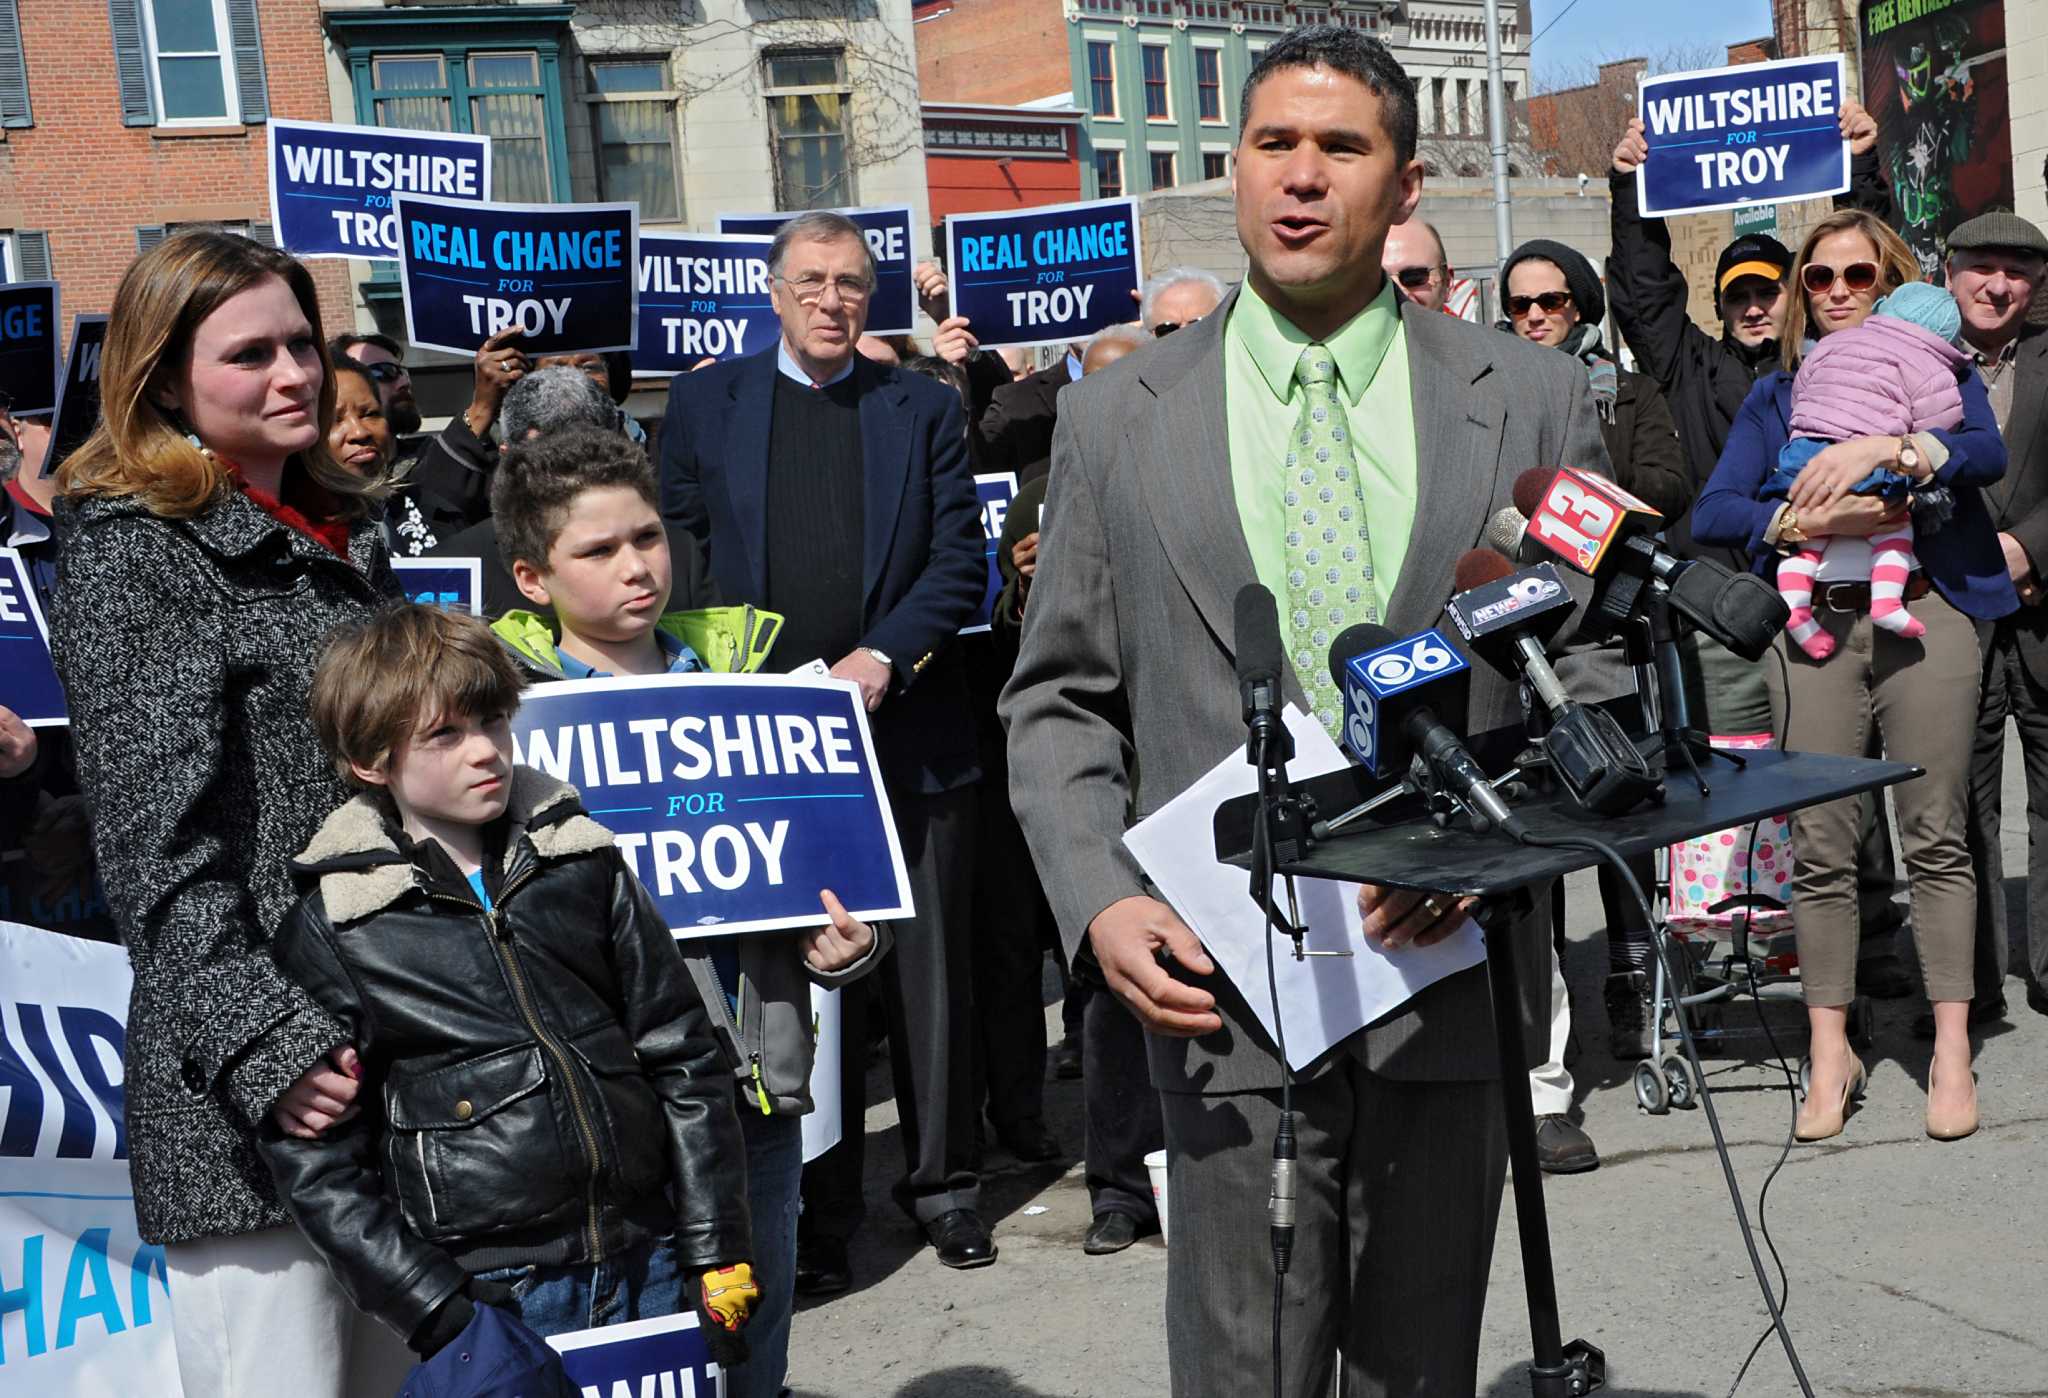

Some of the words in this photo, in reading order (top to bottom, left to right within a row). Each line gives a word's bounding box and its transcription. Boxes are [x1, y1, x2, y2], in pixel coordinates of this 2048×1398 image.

[1647, 78, 1834, 136] WILTSHIRE
[1725, 130, 1757, 145] FOR
[282, 144, 477, 195] WILTSHIRE
[1695, 144, 1790, 190] TROY
[332, 210, 398, 250] TRO
[1734, 206, 1775, 227] Available
[411, 220, 486, 269] REAL
[493, 229, 622, 271] CHANGE
[961, 234, 1028, 272] REAL
[1033, 221, 1128, 266] CHANGE
[497, 279, 534, 292] FOR
[639, 255, 770, 294] ILTSHIR
[1036, 271, 1064, 284] FOR
[463, 294, 572, 338] TROY
[691, 300, 716, 313] FOR
[1007, 284, 1094, 327] TROY
[661, 317, 748, 355] TROY
[1537, 478, 1614, 556] 13
[511, 714, 860, 788] WILTSHIRE
[666, 792, 726, 817] FOR
[613, 819, 790, 896] TROY
